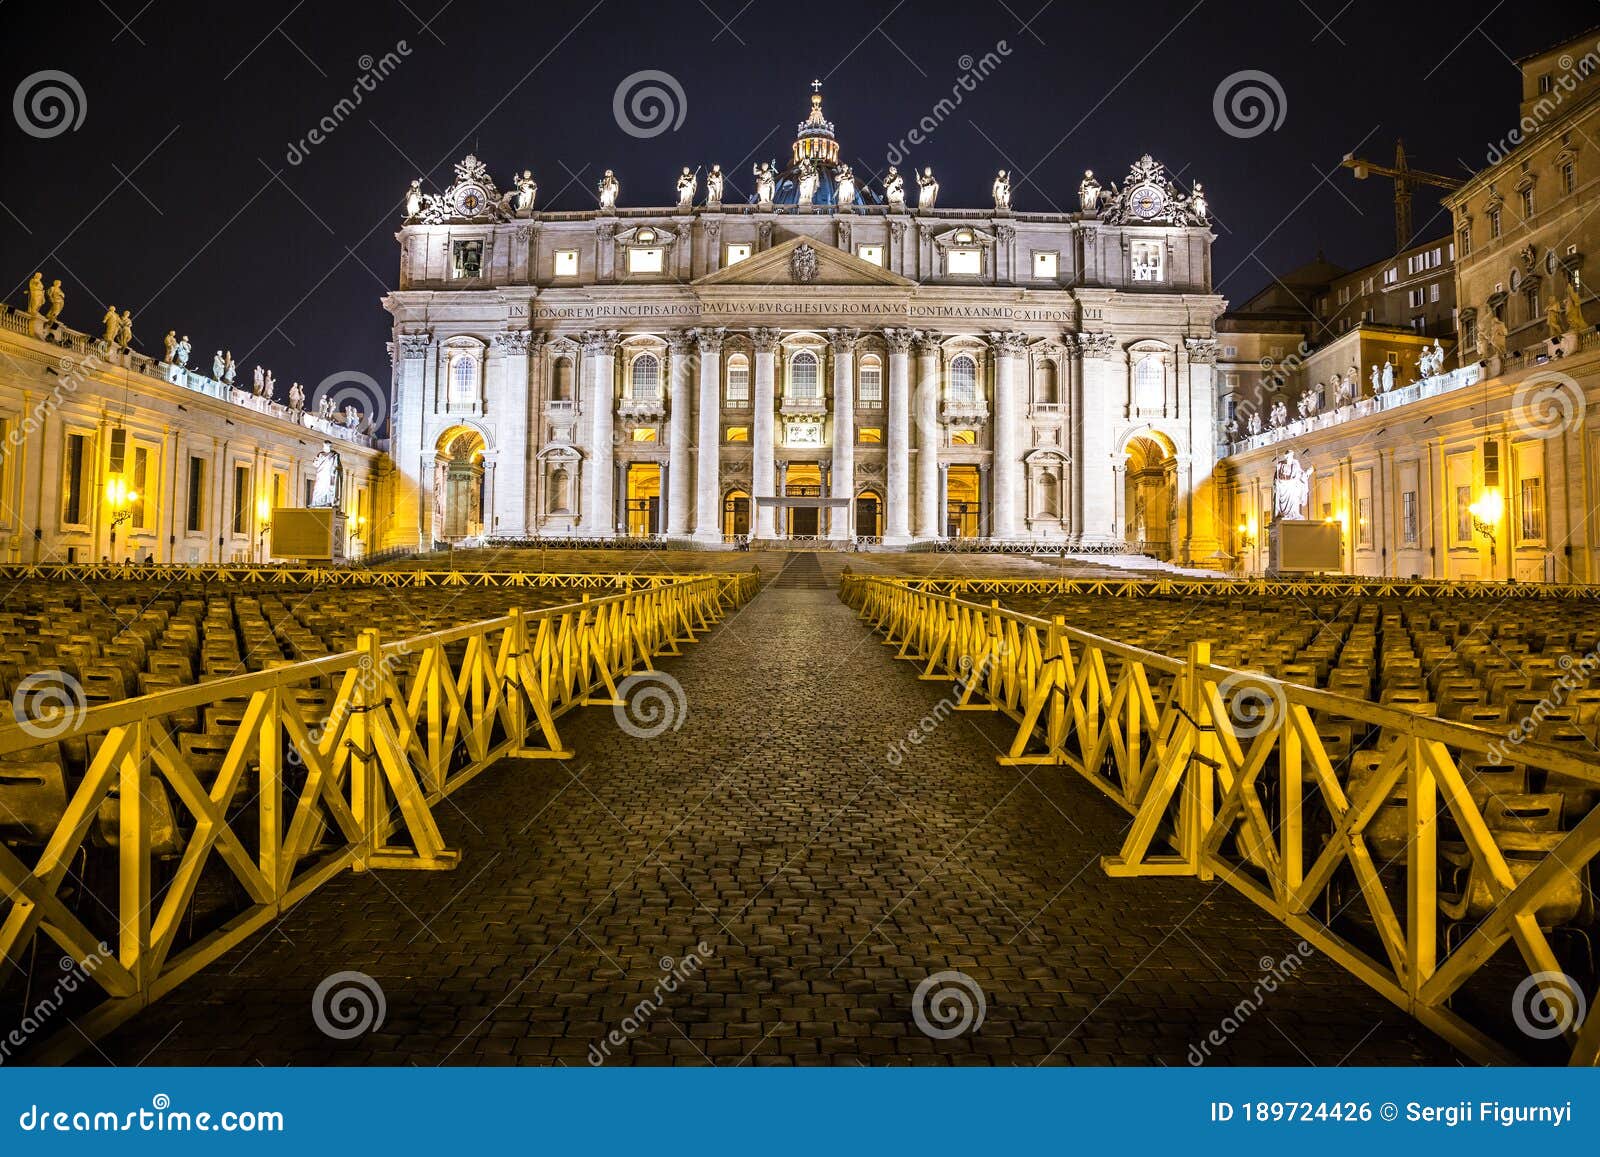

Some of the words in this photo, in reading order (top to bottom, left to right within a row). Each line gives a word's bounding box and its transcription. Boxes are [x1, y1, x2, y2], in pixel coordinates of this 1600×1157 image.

[508, 305, 524, 316] IN
[596, 305, 660, 316] PRINCIPIS
[662, 304, 700, 315] APOST
[702, 303, 746, 313] PAVLVS
[758, 303, 838, 313] BVRGHESIVS
[841, 303, 908, 313] ROMANVS
[1084, 309, 1103, 319] VII
